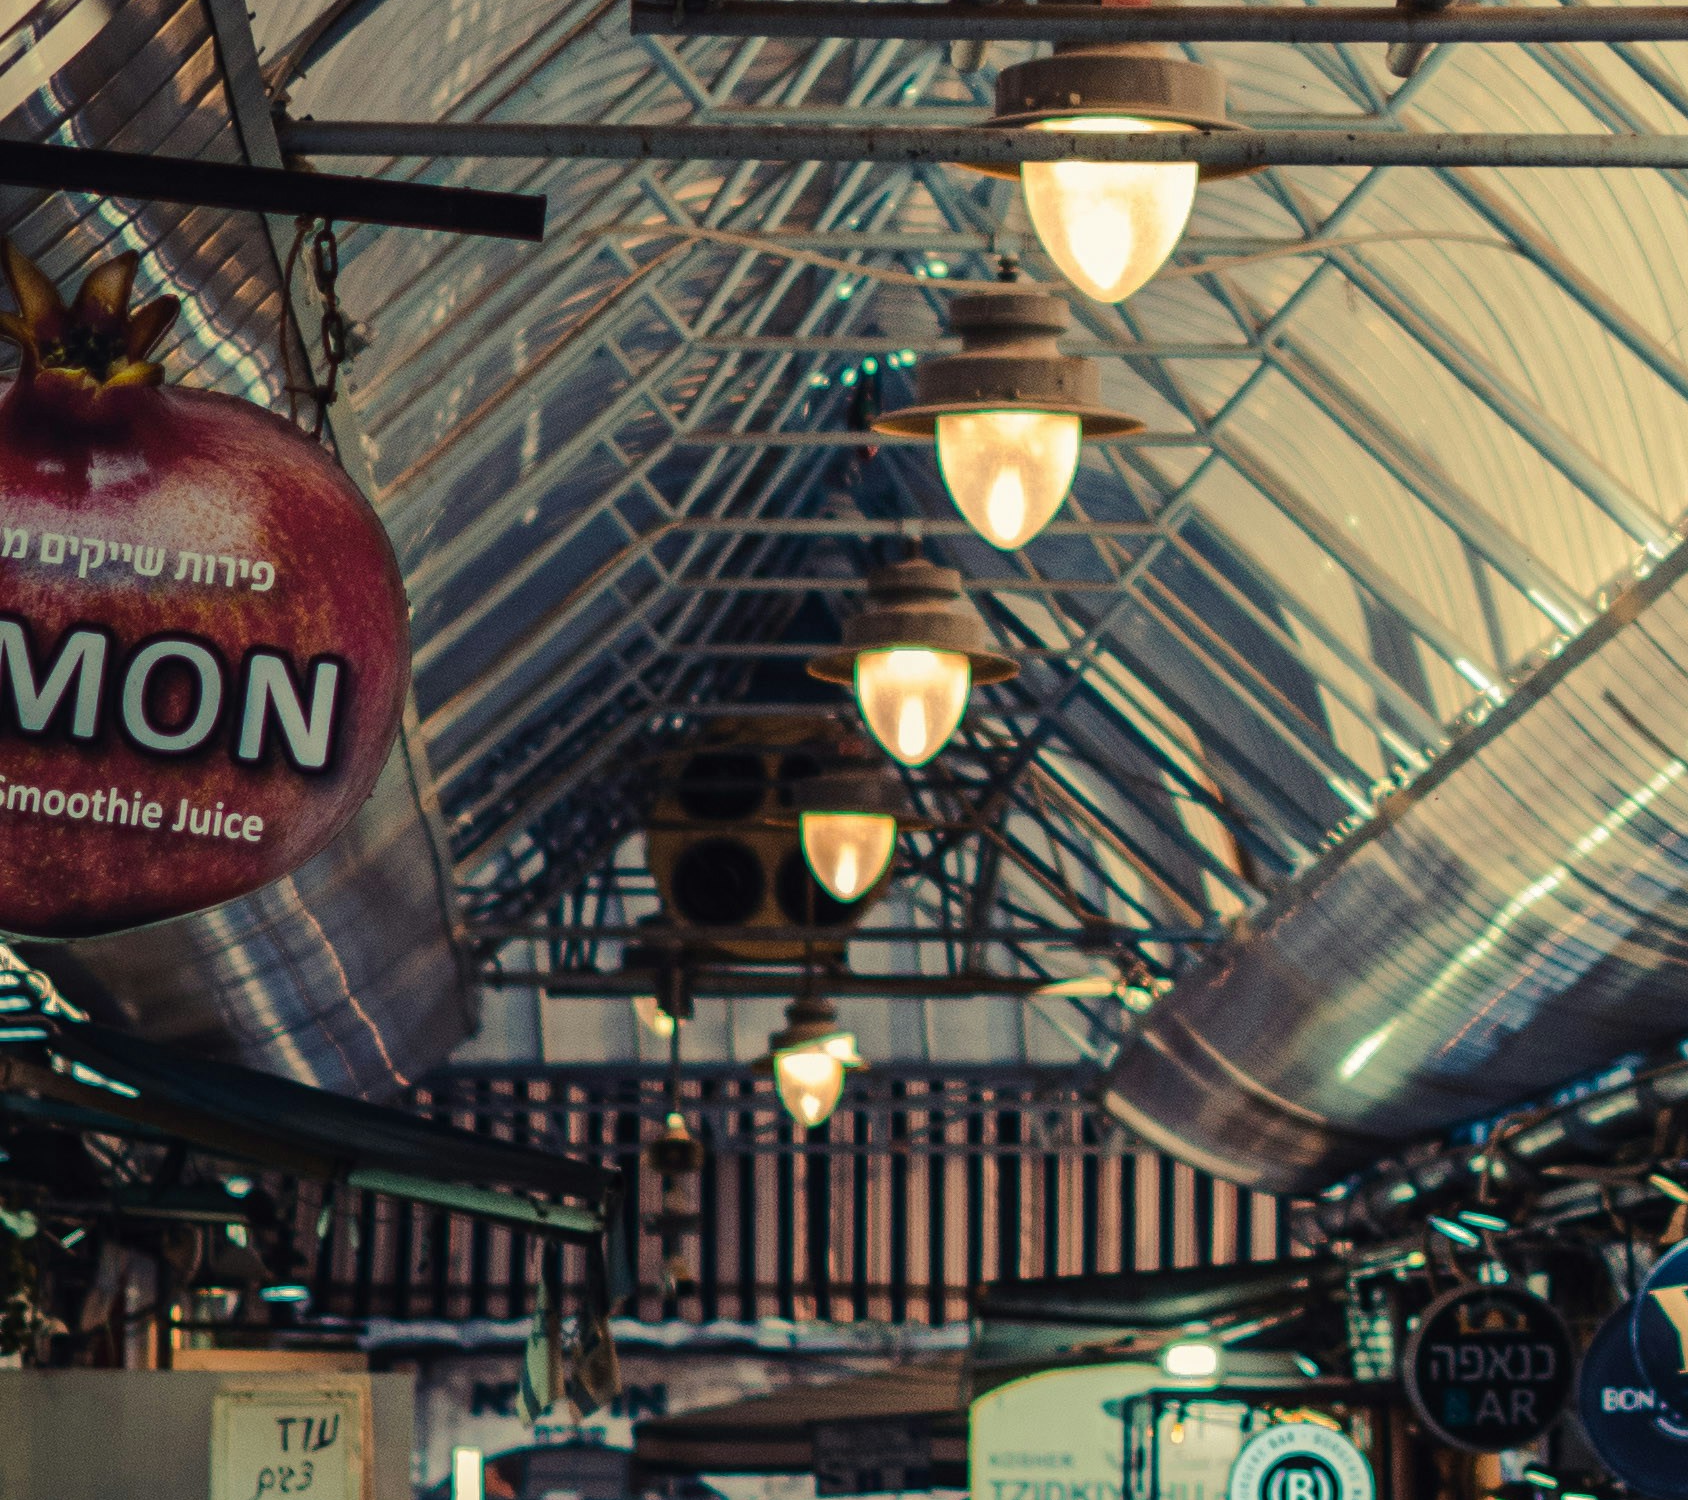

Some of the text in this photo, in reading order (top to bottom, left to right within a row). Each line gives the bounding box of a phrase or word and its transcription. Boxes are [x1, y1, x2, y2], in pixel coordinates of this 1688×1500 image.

[39, 532, 166, 579] שייקים
[174, 551, 275, 592] פירות
[172, 798, 264, 842] Juice
[1430, 1344, 1556, 1381] כנאפה
[1444, 1388, 1538, 1425] BAR
